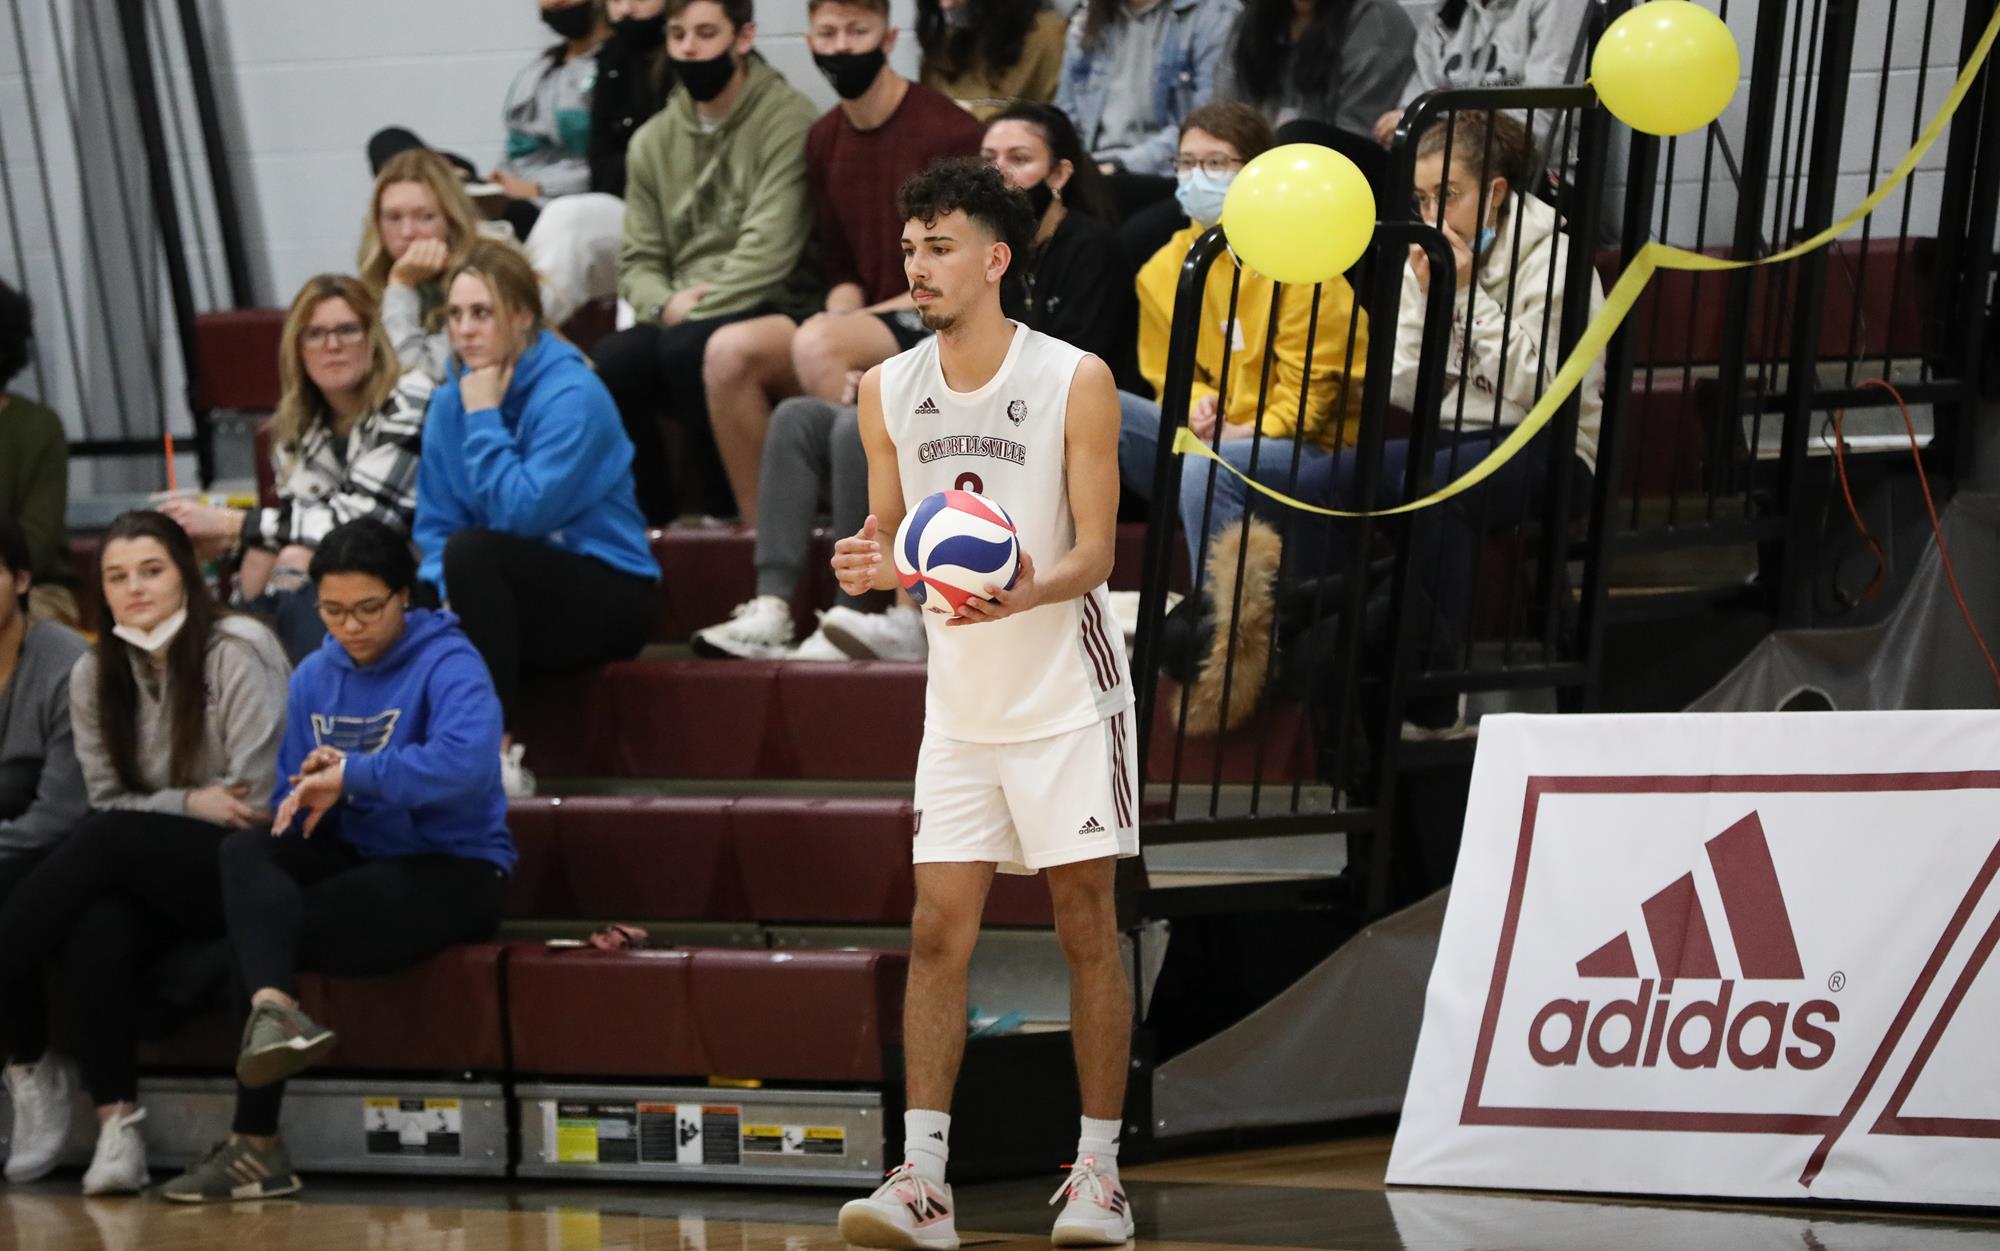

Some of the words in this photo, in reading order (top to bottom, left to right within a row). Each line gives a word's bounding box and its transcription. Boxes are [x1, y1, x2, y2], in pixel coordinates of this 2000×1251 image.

[914, 407, 940, 415] adidas
[918, 435, 1027, 466] CAMPBELLSVILLE
[1078, 826, 1105, 835] adidas
[1528, 978, 1840, 1071] adidas
